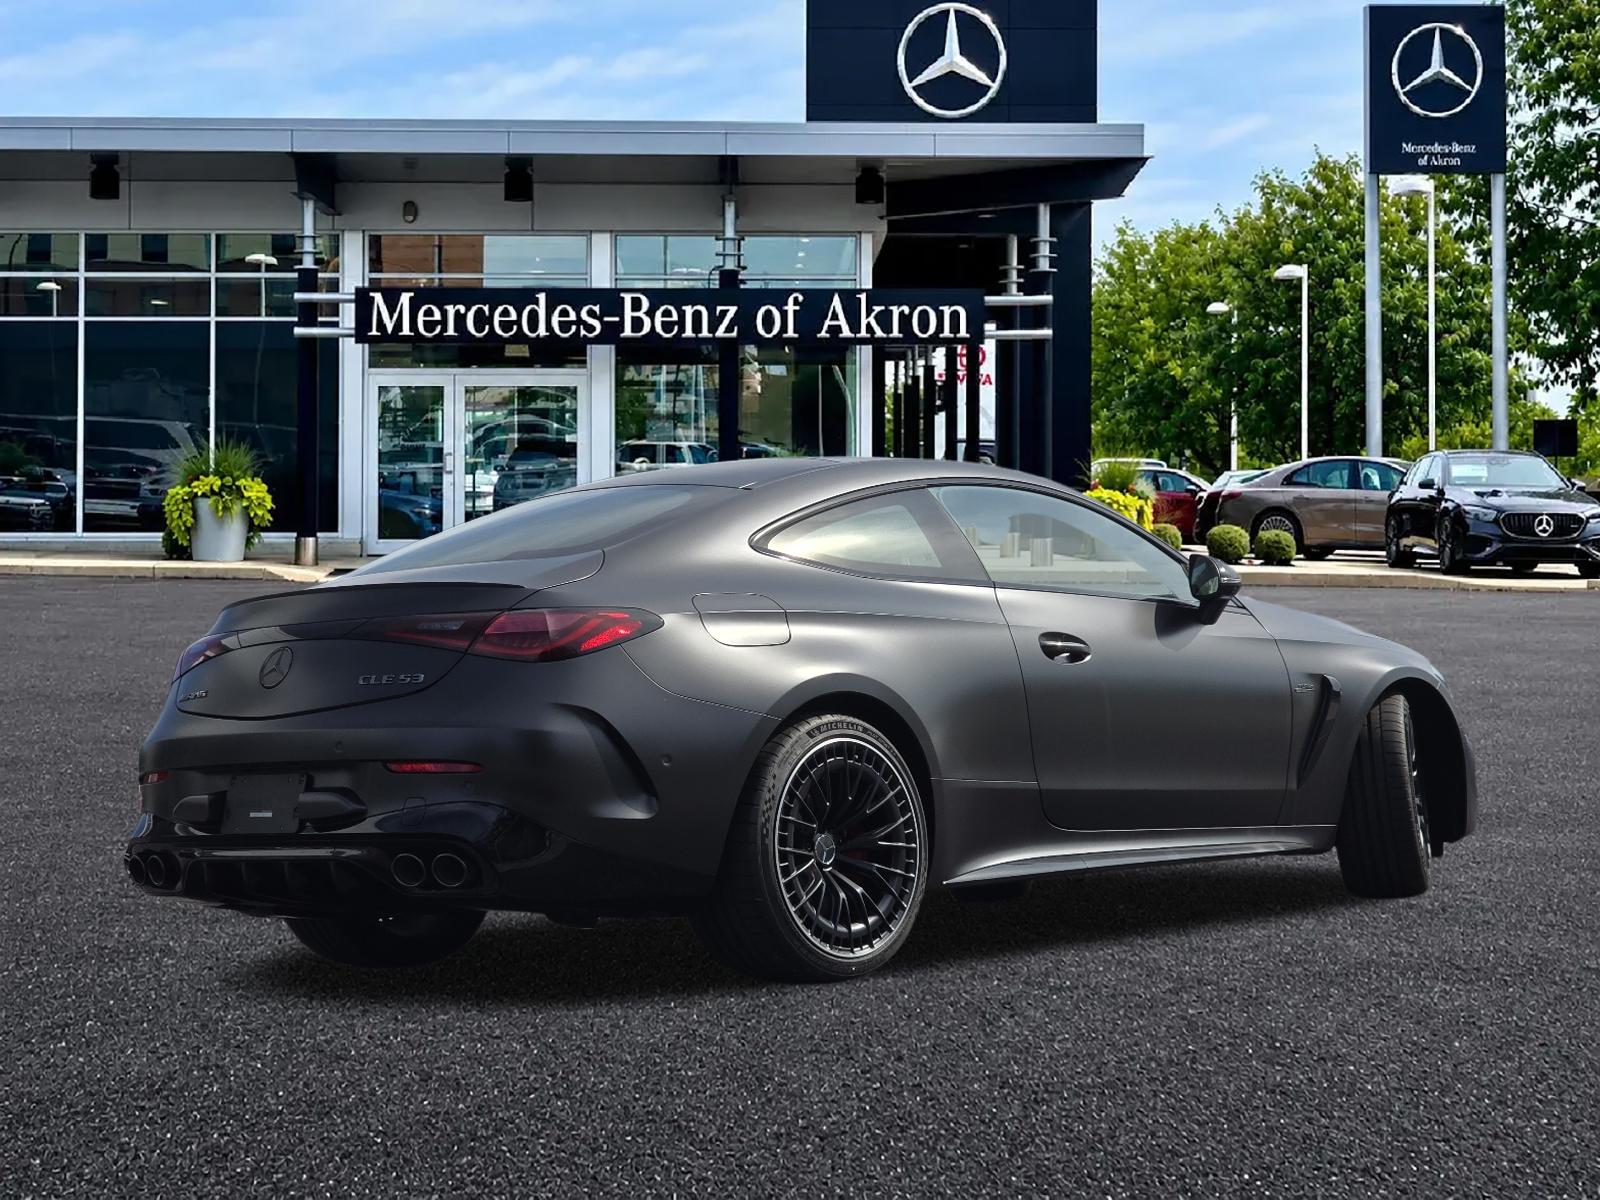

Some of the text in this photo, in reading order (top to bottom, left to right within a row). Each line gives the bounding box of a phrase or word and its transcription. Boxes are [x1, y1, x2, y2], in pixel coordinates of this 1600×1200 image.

[1401, 142, 1476, 153] Mercedes-Benz
[1417, 154, 1461, 166] of Akron
[367, 291, 970, 338] Mercedes-Benz of Akron
[359, 673, 425, 685] CLE 53
[820, 721, 864, 732] MICHELIN
